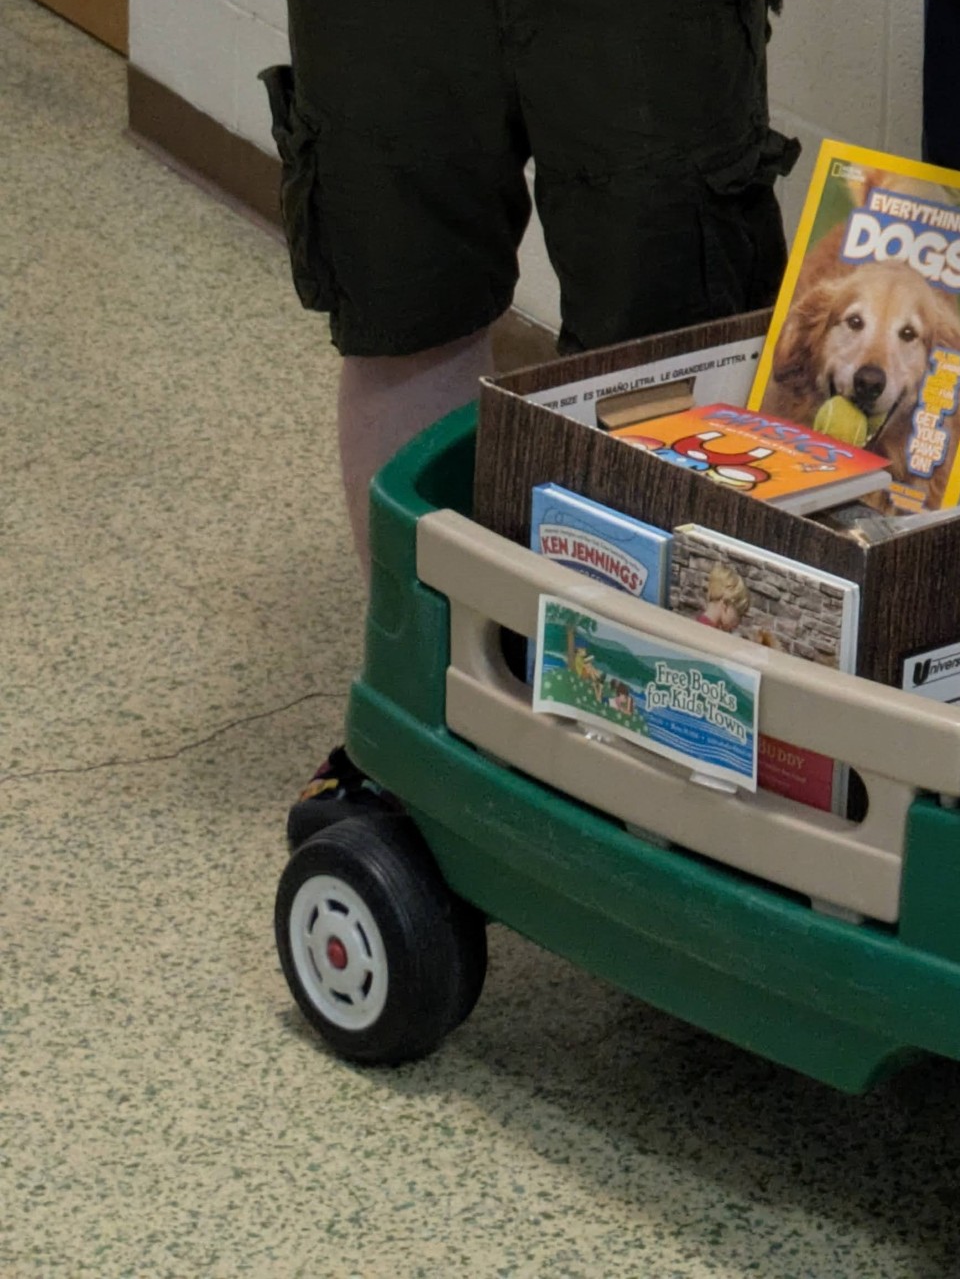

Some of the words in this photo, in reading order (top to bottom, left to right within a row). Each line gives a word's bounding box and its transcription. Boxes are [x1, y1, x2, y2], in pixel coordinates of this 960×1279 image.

[560, 394, 578, 408] SIZE
[583, 389, 595, 402] ES
[630, 376, 655, 391] LETRA
[660, 370, 671, 382] LE
[672, 360, 716, 379] GRANDEUR
[717, 353, 747, 369] LETTRA
[541, 535, 569, 556] KEN
[646, 682, 669, 711] for
[670, 687, 705, 718] Kids
[705, 699, 747, 743] Town
[656, 663, 688, 688] Free
[690, 670, 737, 711] Books
